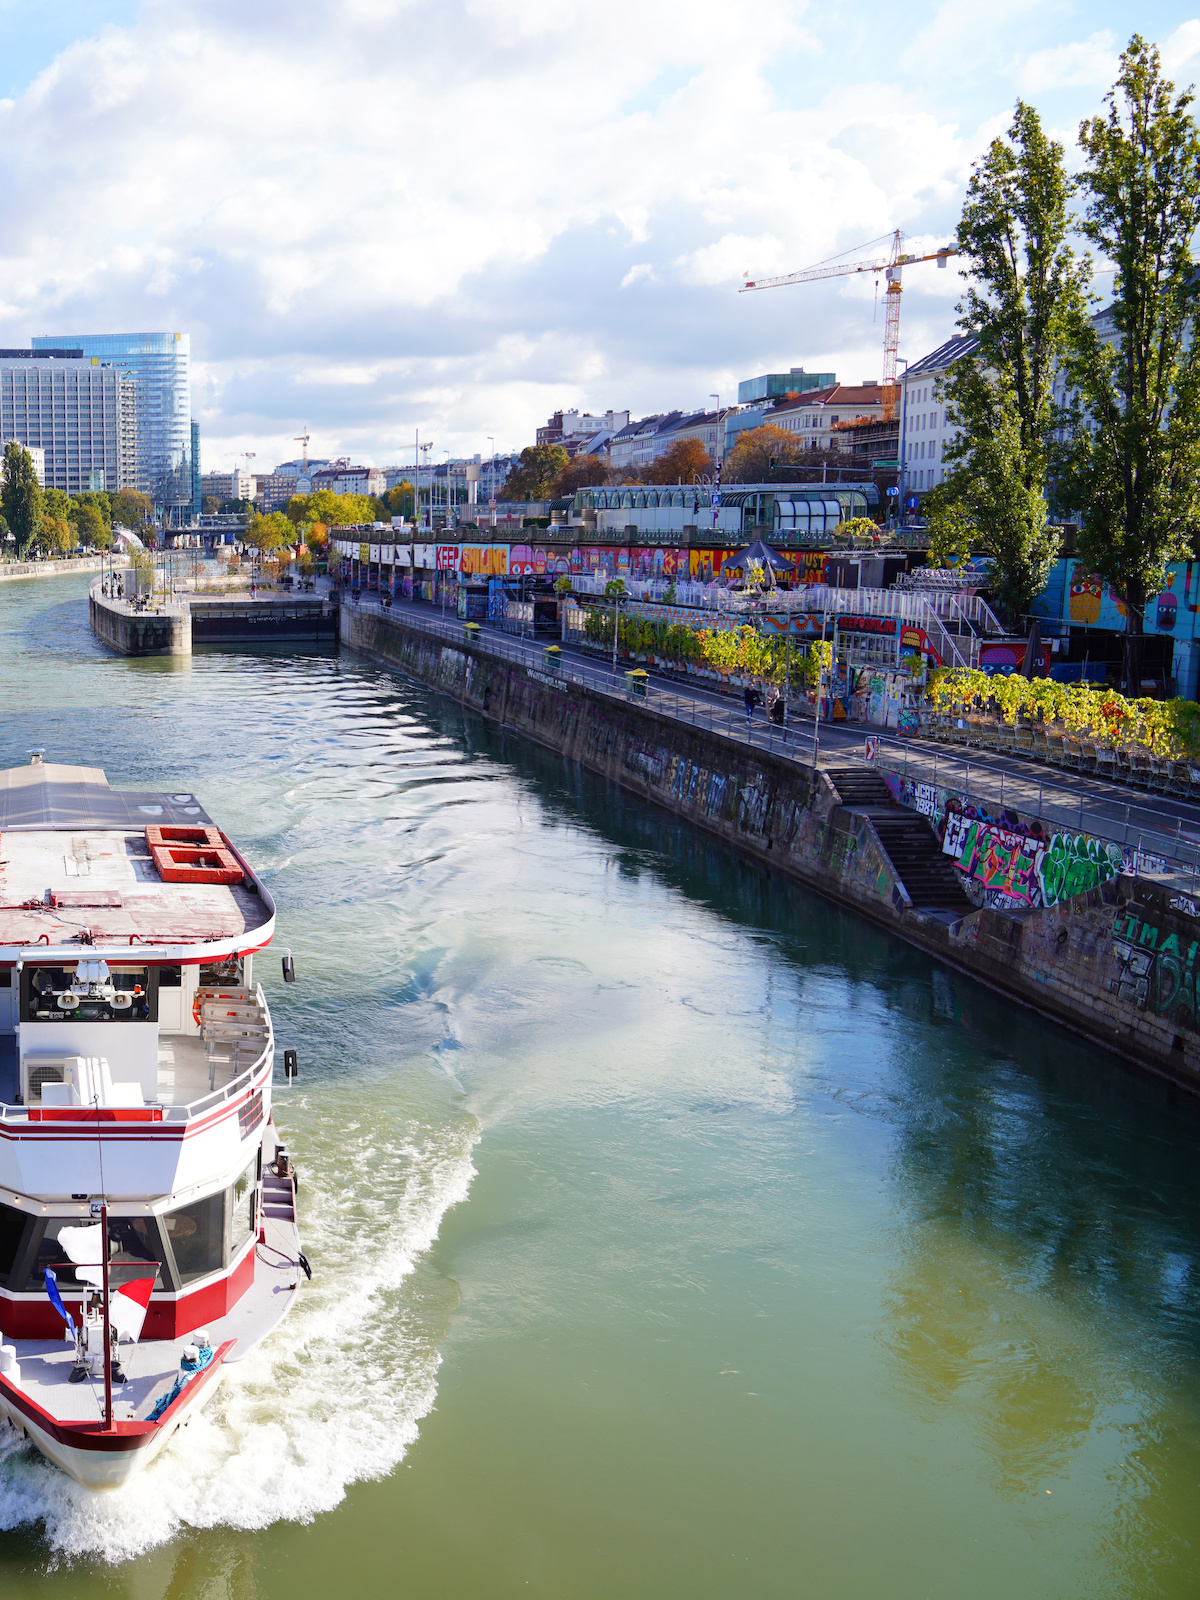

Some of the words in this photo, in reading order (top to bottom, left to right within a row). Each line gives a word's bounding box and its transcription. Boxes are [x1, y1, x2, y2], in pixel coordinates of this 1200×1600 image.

[435, 546, 459, 570] KEEP
[461, 546, 508, 575] SMILING
[839, 616, 858, 629] KEEP
[864, 618, 898, 634] SMILING
